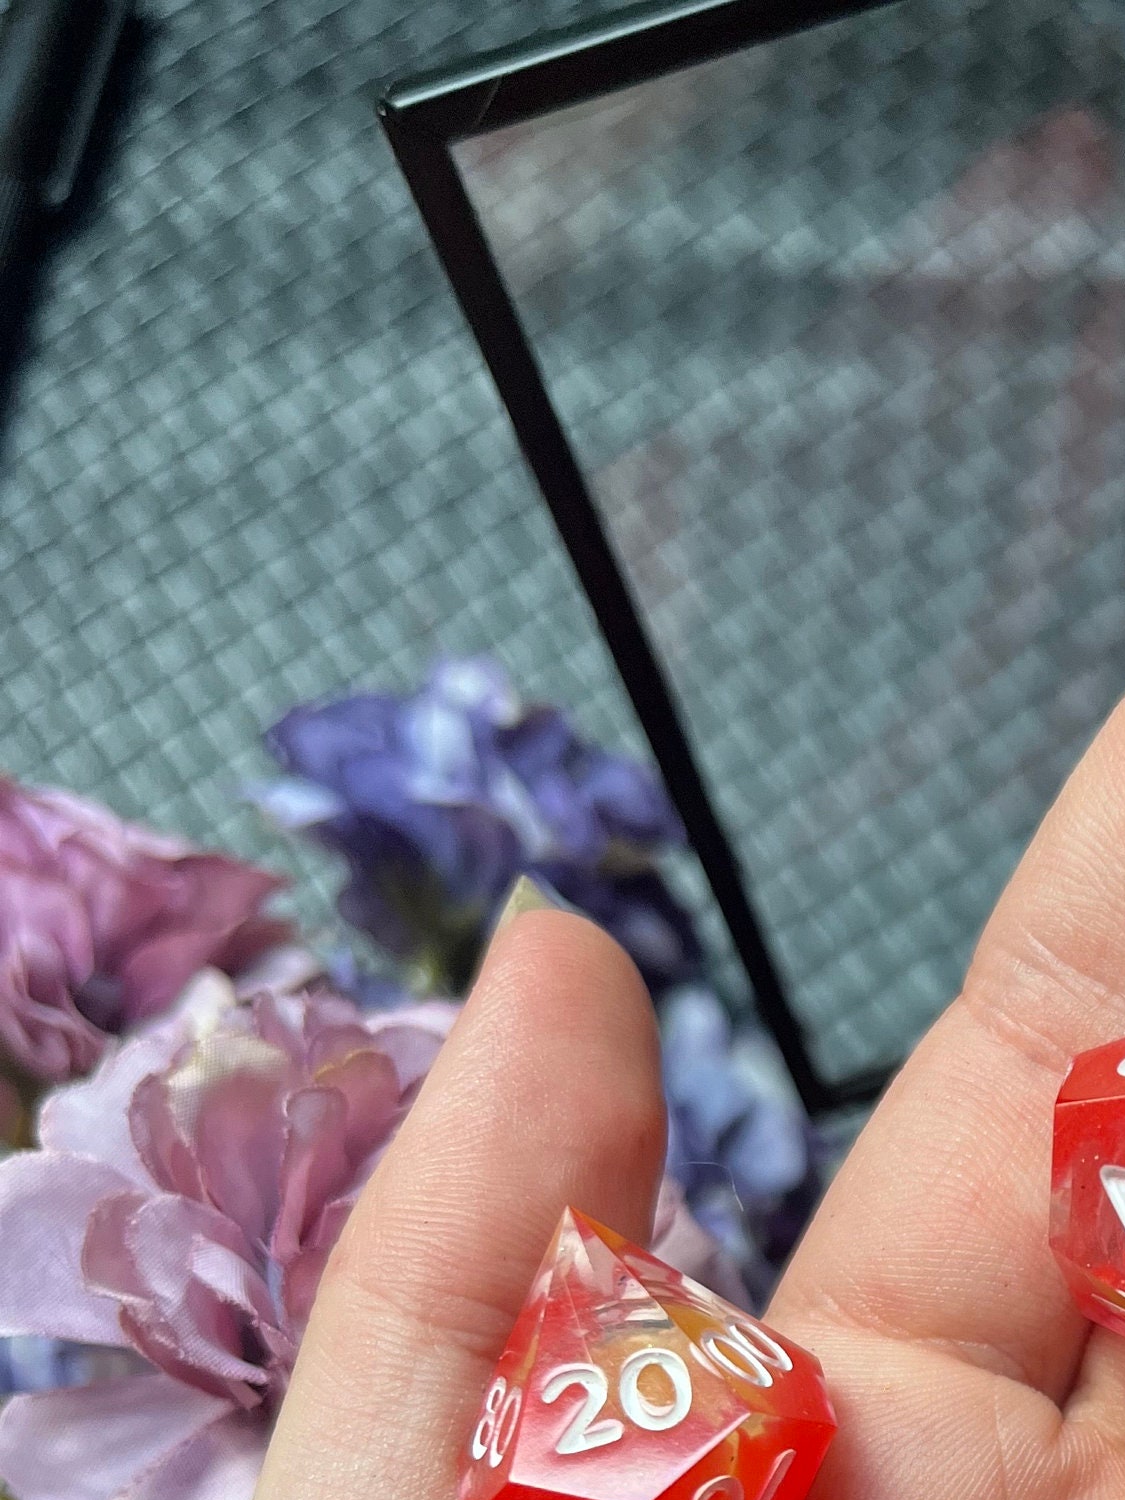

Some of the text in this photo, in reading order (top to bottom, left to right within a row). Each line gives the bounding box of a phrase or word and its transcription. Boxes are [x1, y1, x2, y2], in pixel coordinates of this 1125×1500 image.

[699, 1317, 793, 1388] 00
[472, 1376, 522, 1469] 80
[541, 1346, 693, 1455] 20
